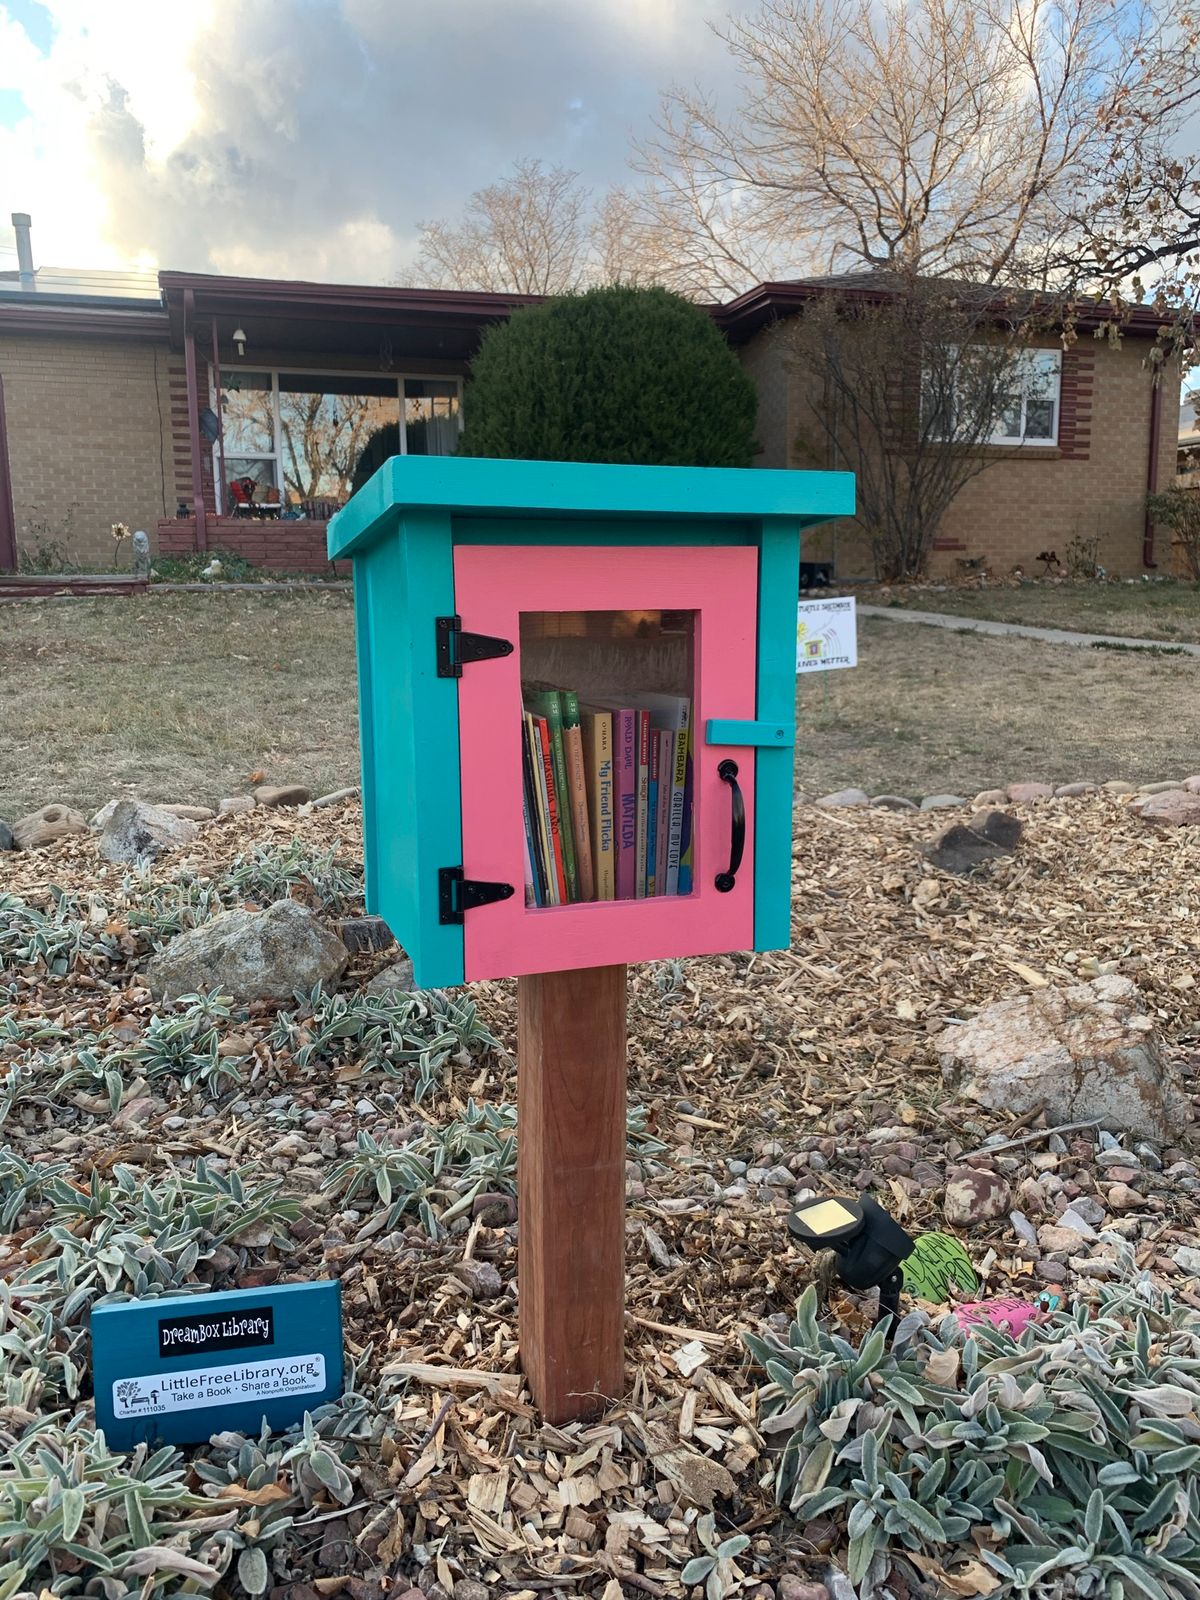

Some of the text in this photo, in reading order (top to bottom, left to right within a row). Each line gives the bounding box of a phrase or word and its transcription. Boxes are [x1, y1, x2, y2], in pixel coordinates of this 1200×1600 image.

[624, 746, 633, 769] DAHL
[675, 733, 686, 783] BAMBARA
[599, 760, 612, 852] My Friend Flicka
[549, 810, 559, 835] TARO
[926, 1257, 978, 1301] HARD
[222, 1317, 269, 1338] Library
[161, 1363, 314, 1391] LittleFreeLibrary.org
[171, 1391, 194, 1402] Take
[207, 1387, 231, 1397] Book
[241, 1381, 270, 1391] Share
[282, 1375, 306, 1386] Book
[261, 1387, 284, 1395] Nonprofit
[285, 1383, 316, 1392] Organization
[143, 1405, 166, 1413] 111035
